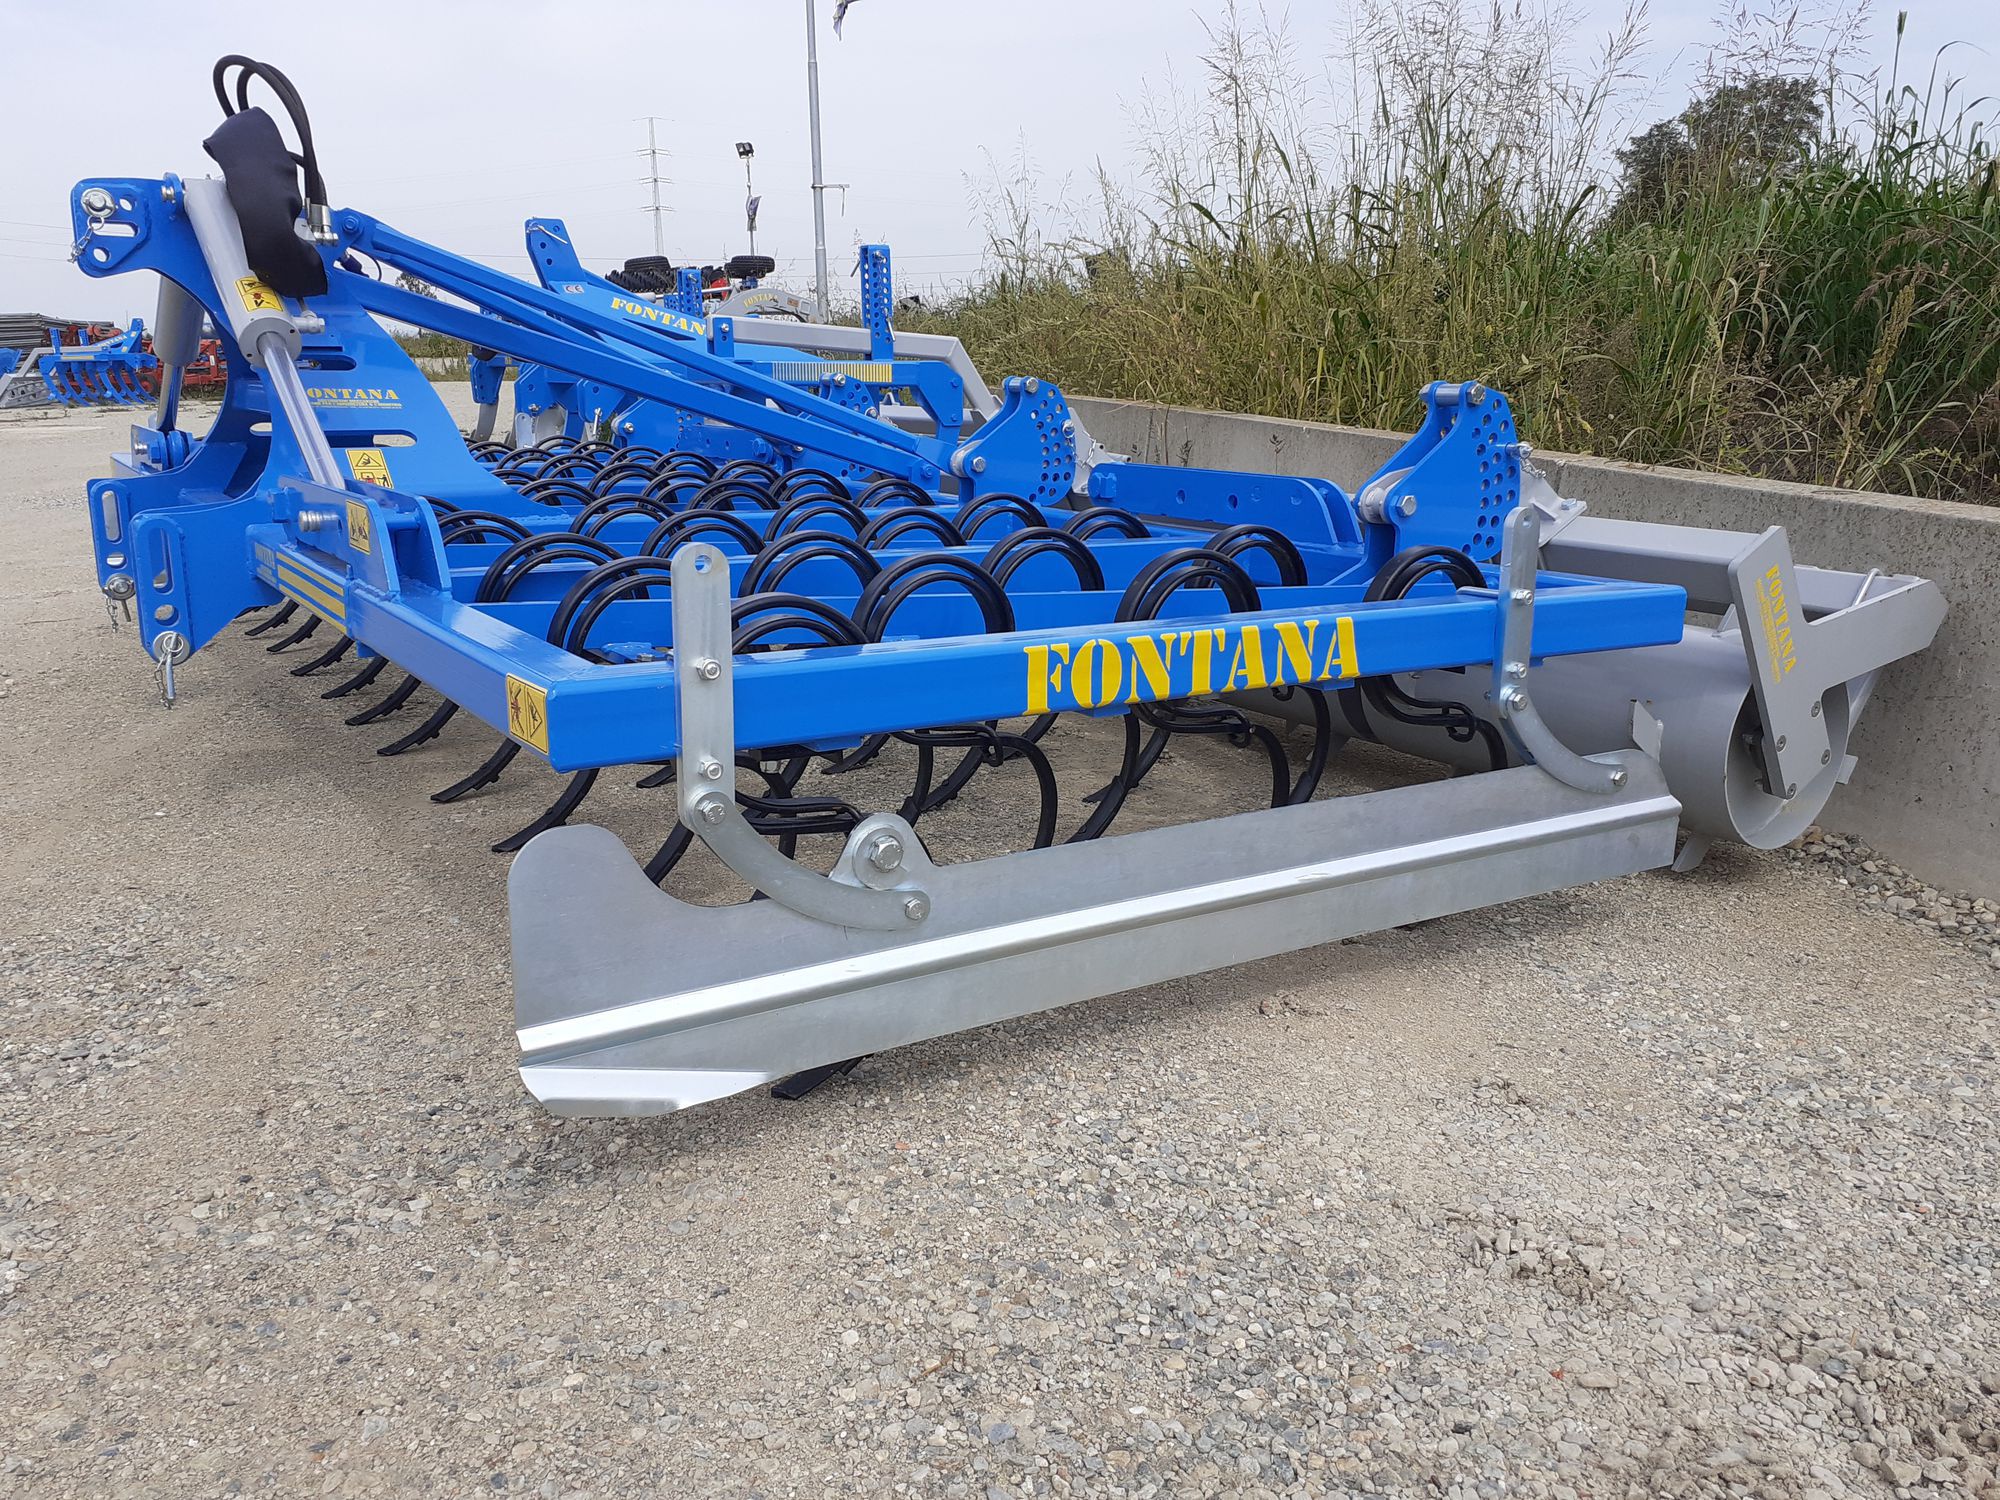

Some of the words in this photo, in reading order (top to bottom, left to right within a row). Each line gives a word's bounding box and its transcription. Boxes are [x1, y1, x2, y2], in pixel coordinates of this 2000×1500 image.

[611, 297, 706, 336] FONTAN
[307, 387, 400, 400] ONTANA
[1767, 565, 1797, 673] FONTANA
[1023, 616, 1360, 716] FONTANA
